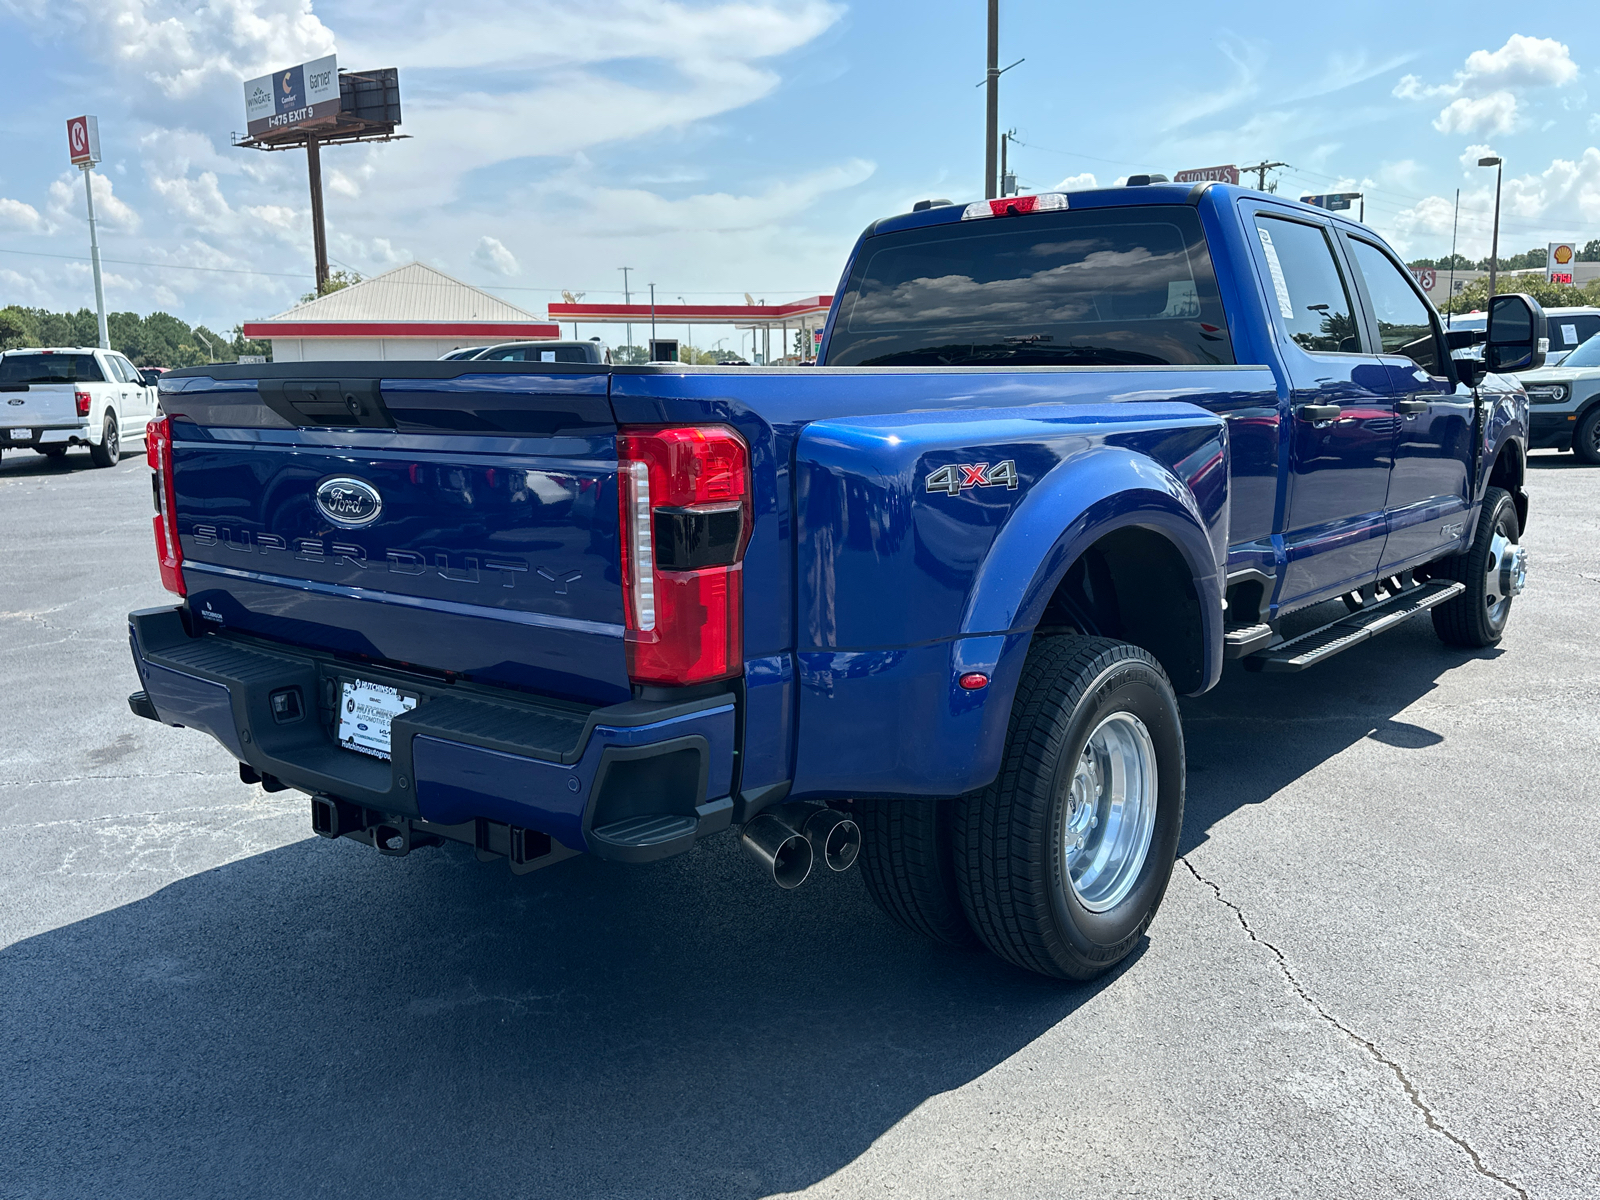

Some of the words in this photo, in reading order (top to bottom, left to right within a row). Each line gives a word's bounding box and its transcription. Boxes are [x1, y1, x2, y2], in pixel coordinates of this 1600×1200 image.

[309, 70, 331, 89] Garner
[247, 93, 271, 107] WINGATE
[281, 95, 297, 104] Comfort
[268, 112, 288, 128] I-475
[288, 108, 308, 123] EXIT
[308, 106, 314, 118] 9
[329, 487, 362, 513] Ford
[193, 524, 368, 569] SUPER
[386, 547, 582, 595] DUTY
[361, 680, 398, 696] HUTCHINSON
[356, 713, 386, 726] AUTOMOTIVE
